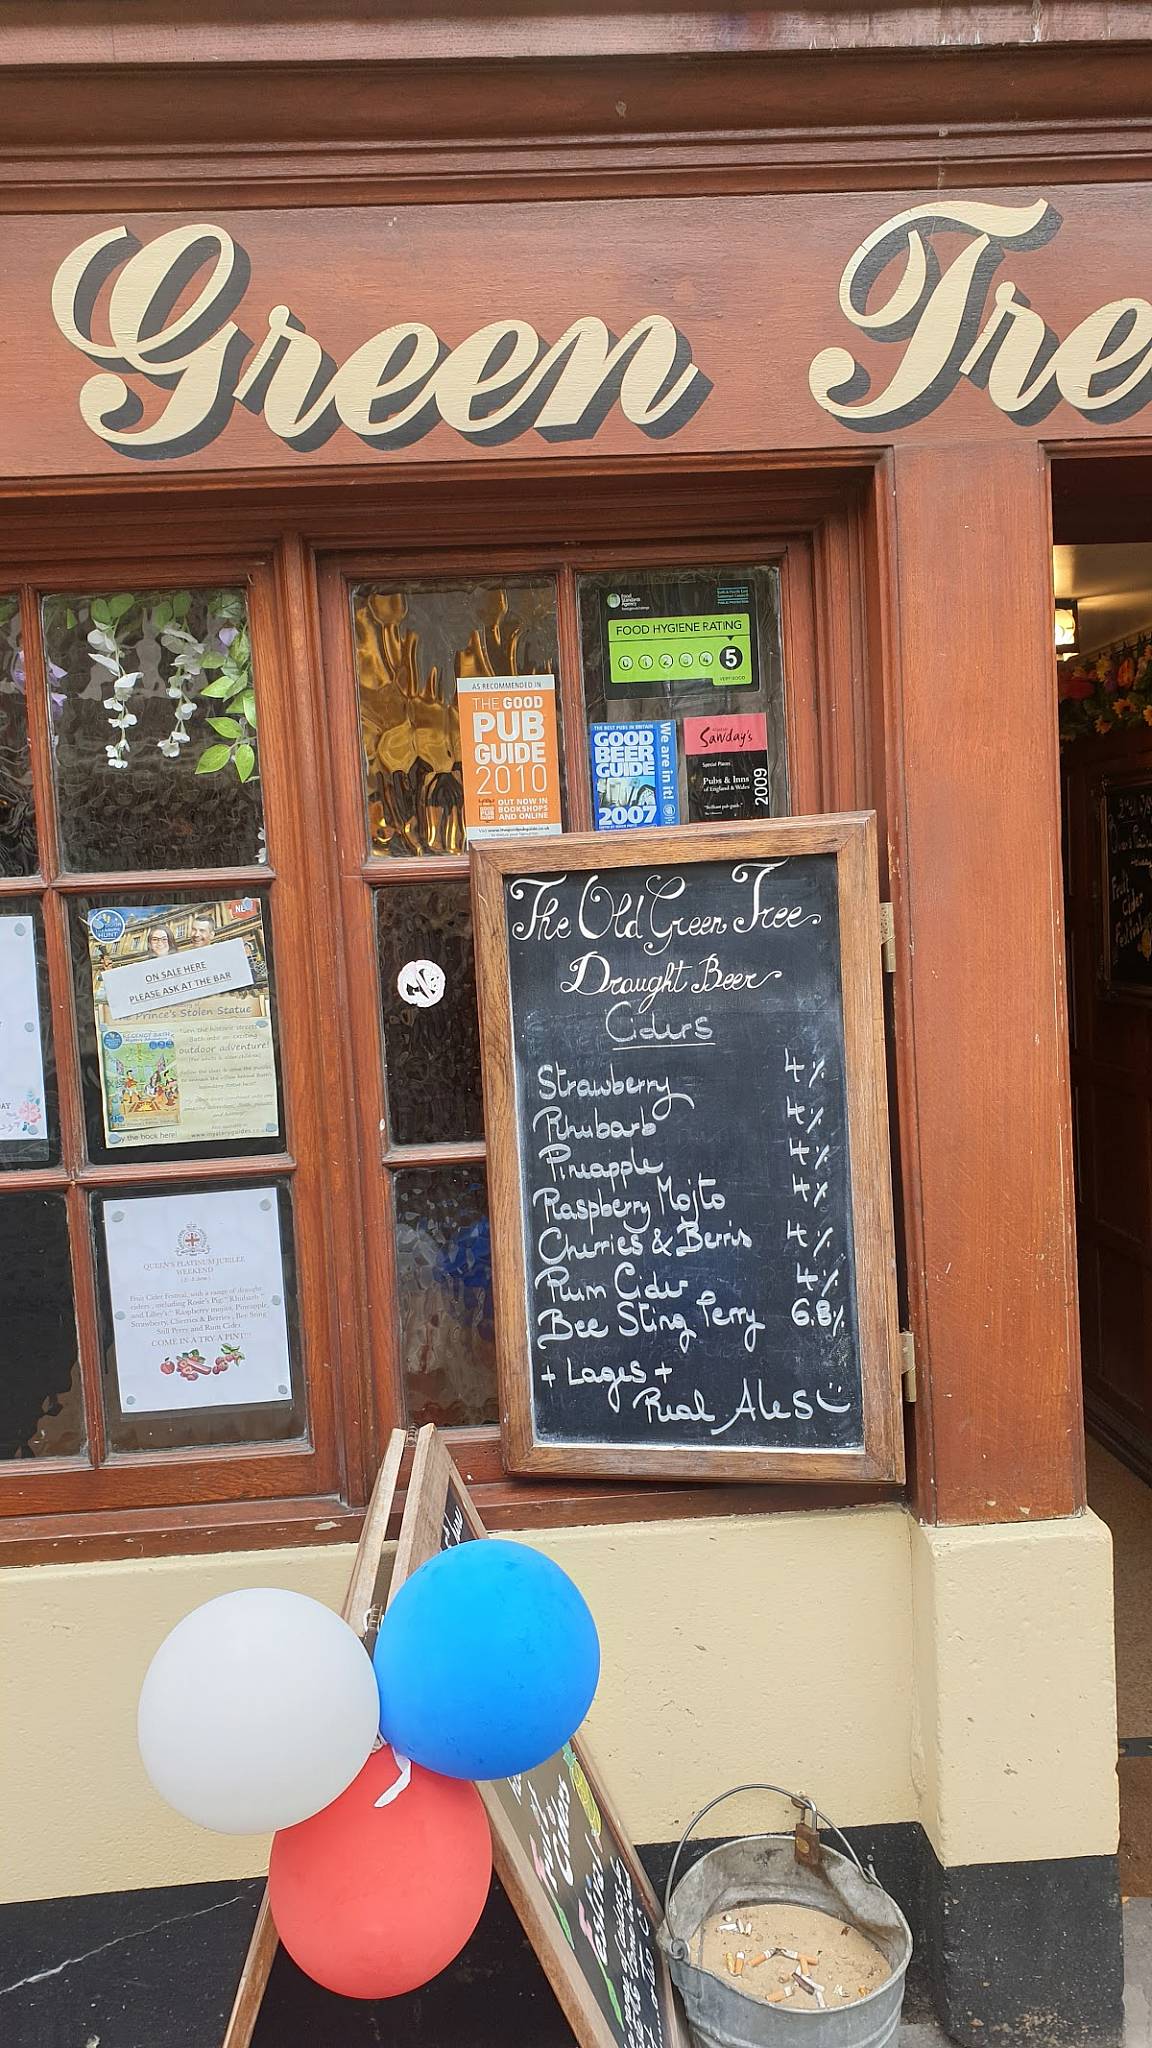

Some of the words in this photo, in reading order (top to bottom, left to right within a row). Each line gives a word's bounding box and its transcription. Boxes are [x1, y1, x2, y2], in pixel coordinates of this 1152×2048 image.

[52, 224, 704, 454] Green
[616, 625, 650, 636] FOOD
[653, 622, 700, 634] HYGIENE
[702, 619, 742, 632] RATING
[725, 649, 738, 668] 5
[472, 697, 499, 710] THE
[503, 696, 543, 709] GOOD
[473, 710, 544, 742] PUB
[660, 722, 671, 743] We
[594, 731, 654, 746] GOOD
[700, 727, 753, 748] Sawday's
[475, 741, 546, 765] GUIDE
[595, 745, 654, 763] BEER
[661, 746, 670, 767] are
[475, 764, 547, 794] 2010
[596, 761, 655, 777] GUIDE
[662, 770, 673, 782] in
[703, 776, 722, 785] Pubs
[732, 775, 750, 783] Inns
[710, 785, 730, 793] England
[753, 767, 769, 806] 2009
[516, 798, 537, 806] NOW
[663, 786, 674, 800] it!
[498, 804, 548, 813] BOOKSHOPS
[599, 806, 656, 825] 2007
[510, 873, 571, 942] The
[578, 874, 644, 940] Old
[643, 874, 728, 956] Green
[731, 857, 823, 934] Tree
[145, 972, 160, 983] ON
[162, 967, 183, 979] SALE
[184, 961, 207, 974] HERE
[560, 950, 692, 1014] Draught
[691, 953, 783, 994] Beer
[129, 988, 162, 1004] PLEASE
[162, 984, 181, 996] ASK
[181, 980, 194, 991] AT
[195, 976, 212, 988] THE
[214, 971, 233, 984] BAR
[135, 1009, 177, 1020] Prince's
[180, 1007, 214, 1018] Stolen
[217, 1005, 252, 1016] Statue
[178, 1045, 216, 1055] outdoor
[219, 1041, 270, 1053] adventure!
[537, 1060, 695, 1121] Strawberry
[532, 1105, 658, 1143] Rhubarb
[532, 1186, 652, 1235] Raspberry
[651, 1227, 674, 1258] &
[176, 1267, 214, 1275] WEEKEND
[534, 1265, 608, 1303] Rum
[537, 1308, 610, 1350] Bee
[616, 1301, 697, 1354] Sting
[695, 1290, 766, 1353] Perry
[152, 1338, 177, 1348] COME
[179, 1337, 189, 1345] IN
[190, 1336, 198, 1344] A
[199, 1335, 217, 1343] TRY
[217, 1333, 225, 1342] A
[632, 1386, 718, 1425] Real
[710, 1378, 814, 1435] Ales
[547, 1774, 574, 1887] Cider
